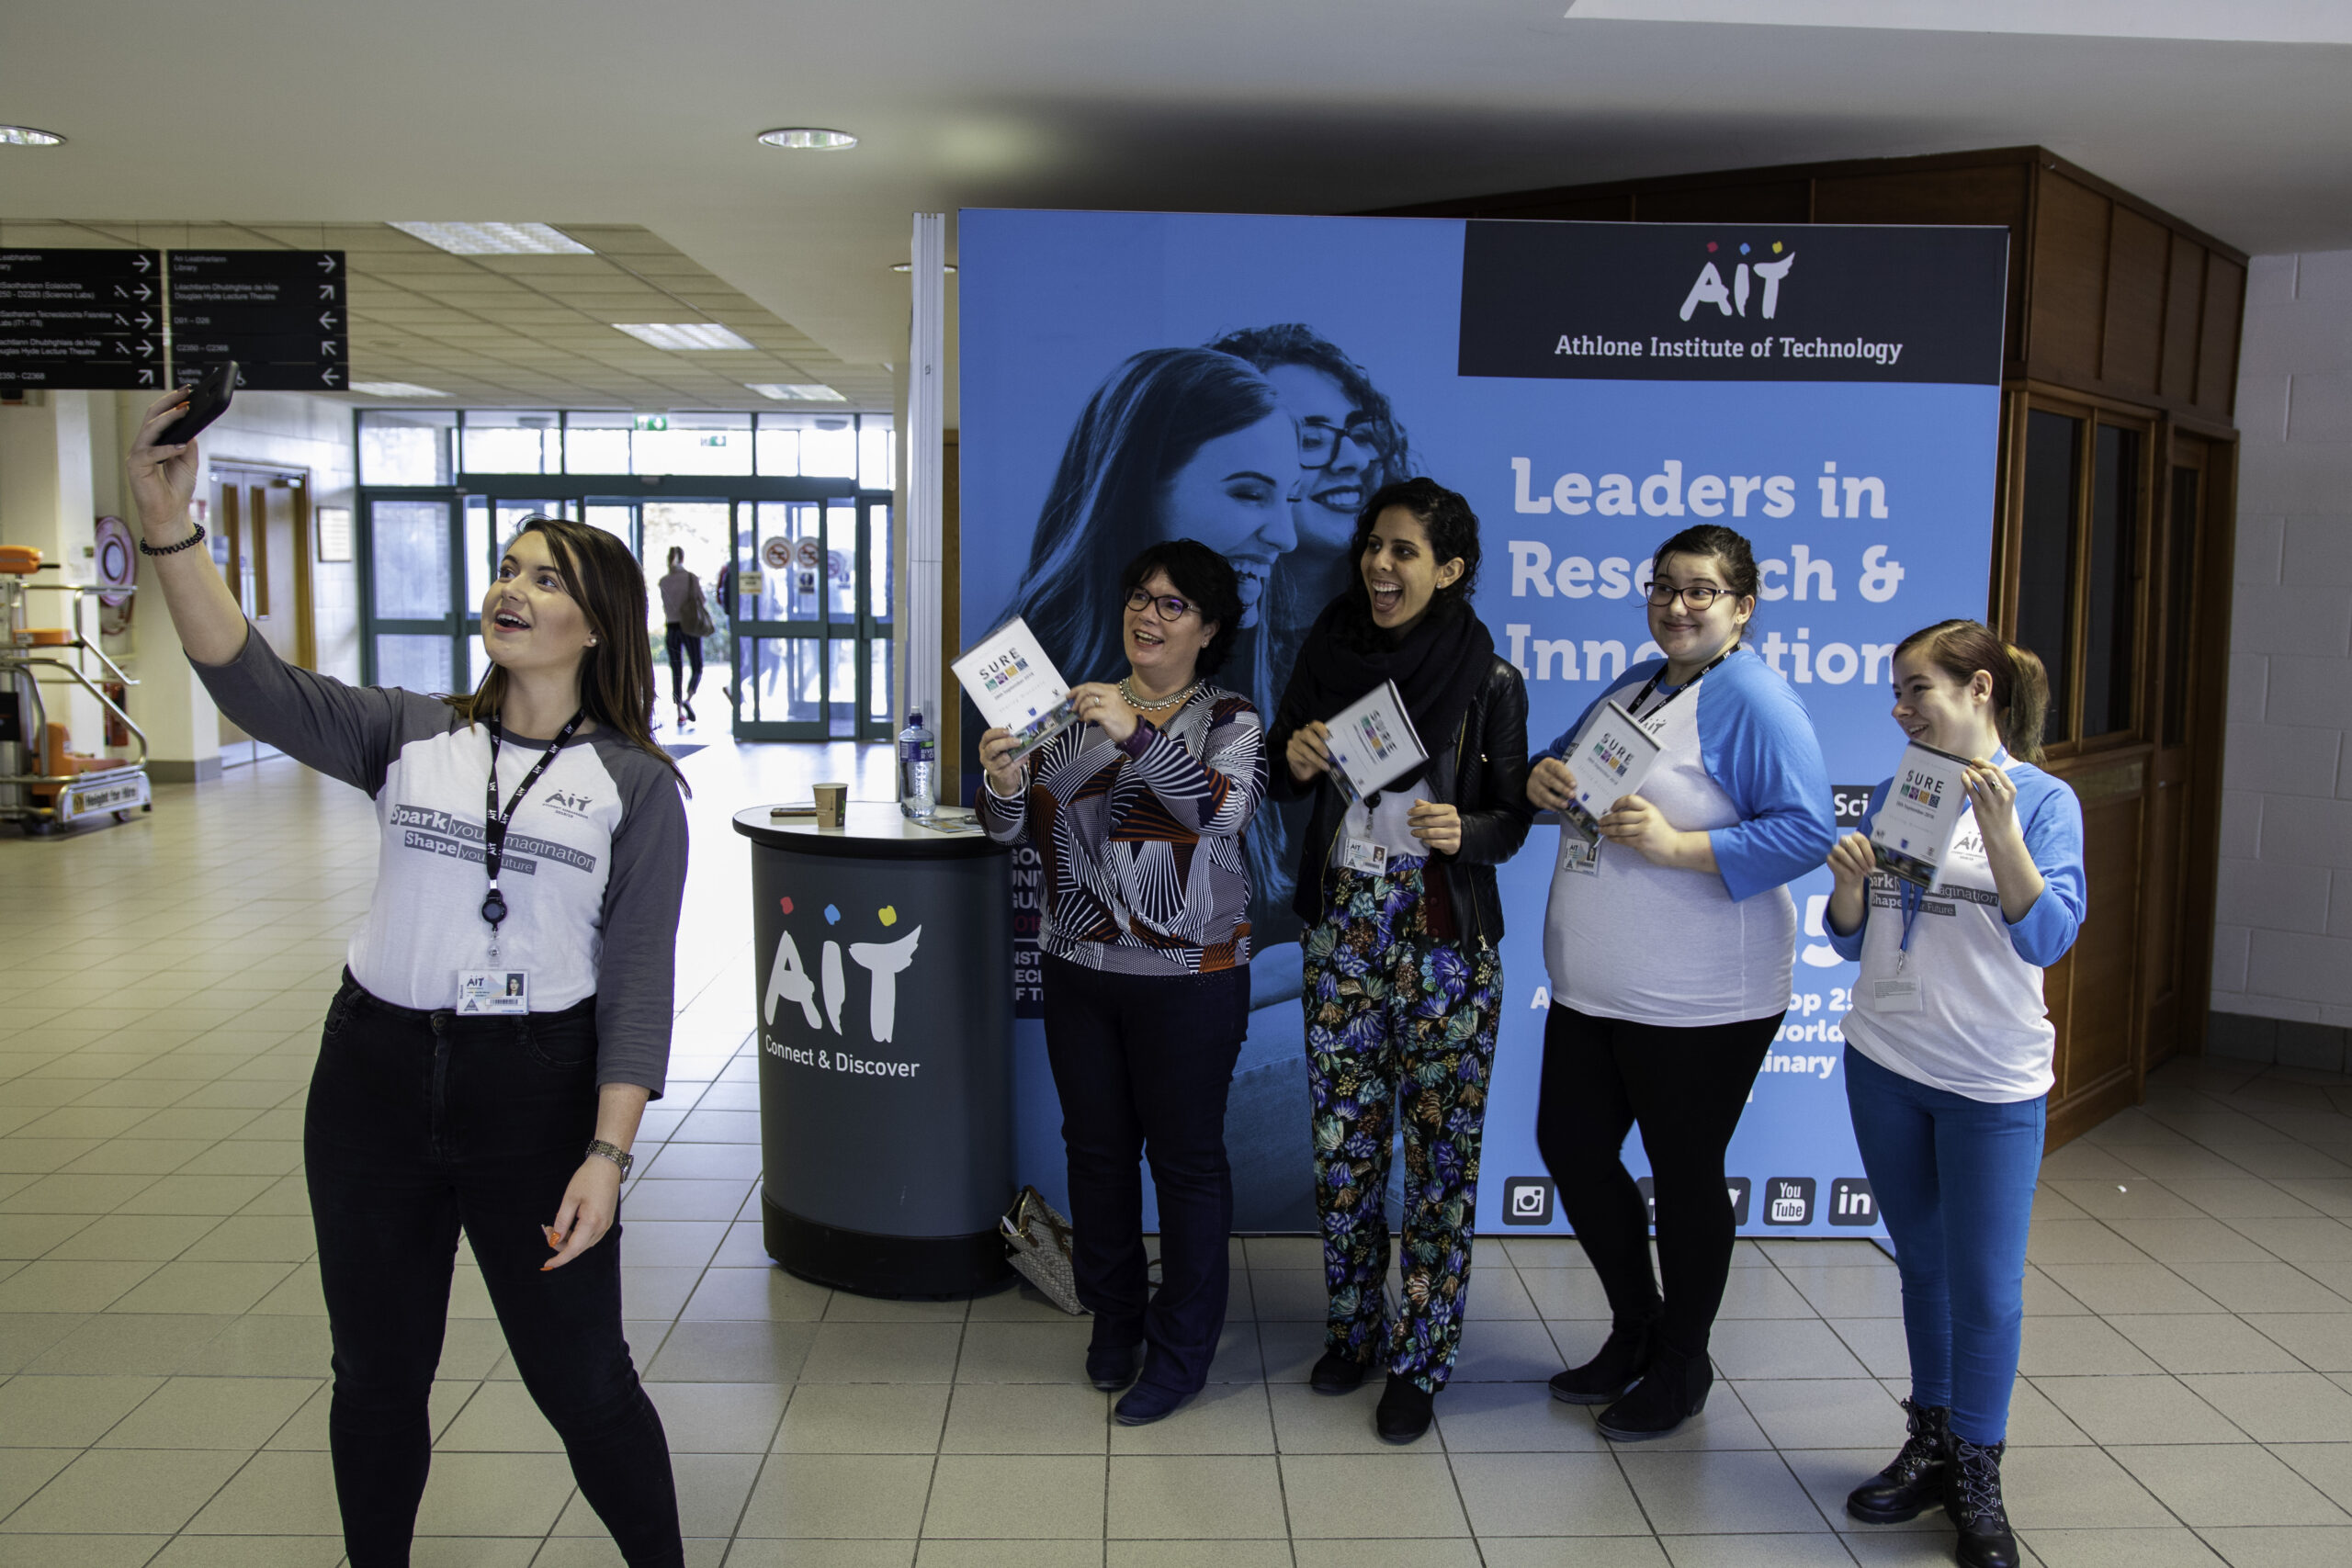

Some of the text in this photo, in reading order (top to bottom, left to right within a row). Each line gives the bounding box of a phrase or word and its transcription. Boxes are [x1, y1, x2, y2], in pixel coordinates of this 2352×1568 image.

[174, 264, 198, 273] Library
[175, 293, 202, 301] Douglas
[204, 293, 221, 301] Hyde
[1679, 248, 1795, 321] AIT
[21, 348, 40, 356] Hyde
[69, 347, 96, 355] Theatre
[1554, 334, 1903, 365] Athlone Institute of Technology
[1510, 457, 1889, 519] Leaders in
[1509, 541, 1905, 603] Resch &
[979, 648, 1021, 681] SURE
[1506, 624, 1897, 684] Inntion
[1600, 732, 1634, 766] SURE
[1906, 770, 1944, 794] SURE
[545, 793, 593, 812] AIT
[390, 804, 595, 871] Spark you magination
[405, 832, 534, 873] Shape you uture
[1870, 874, 1894, 889] ark
[1939, 885, 1998, 904] agination
[466, 977, 484, 987] AIT
[764, 924, 922, 1043] AIT
[764, 1034, 921, 1077] Connect & Discover
[1779, 1182, 1802, 1200] You
[1838, 1185, 1871, 1215] in
[1775, 1202, 1804, 1218] Tube
